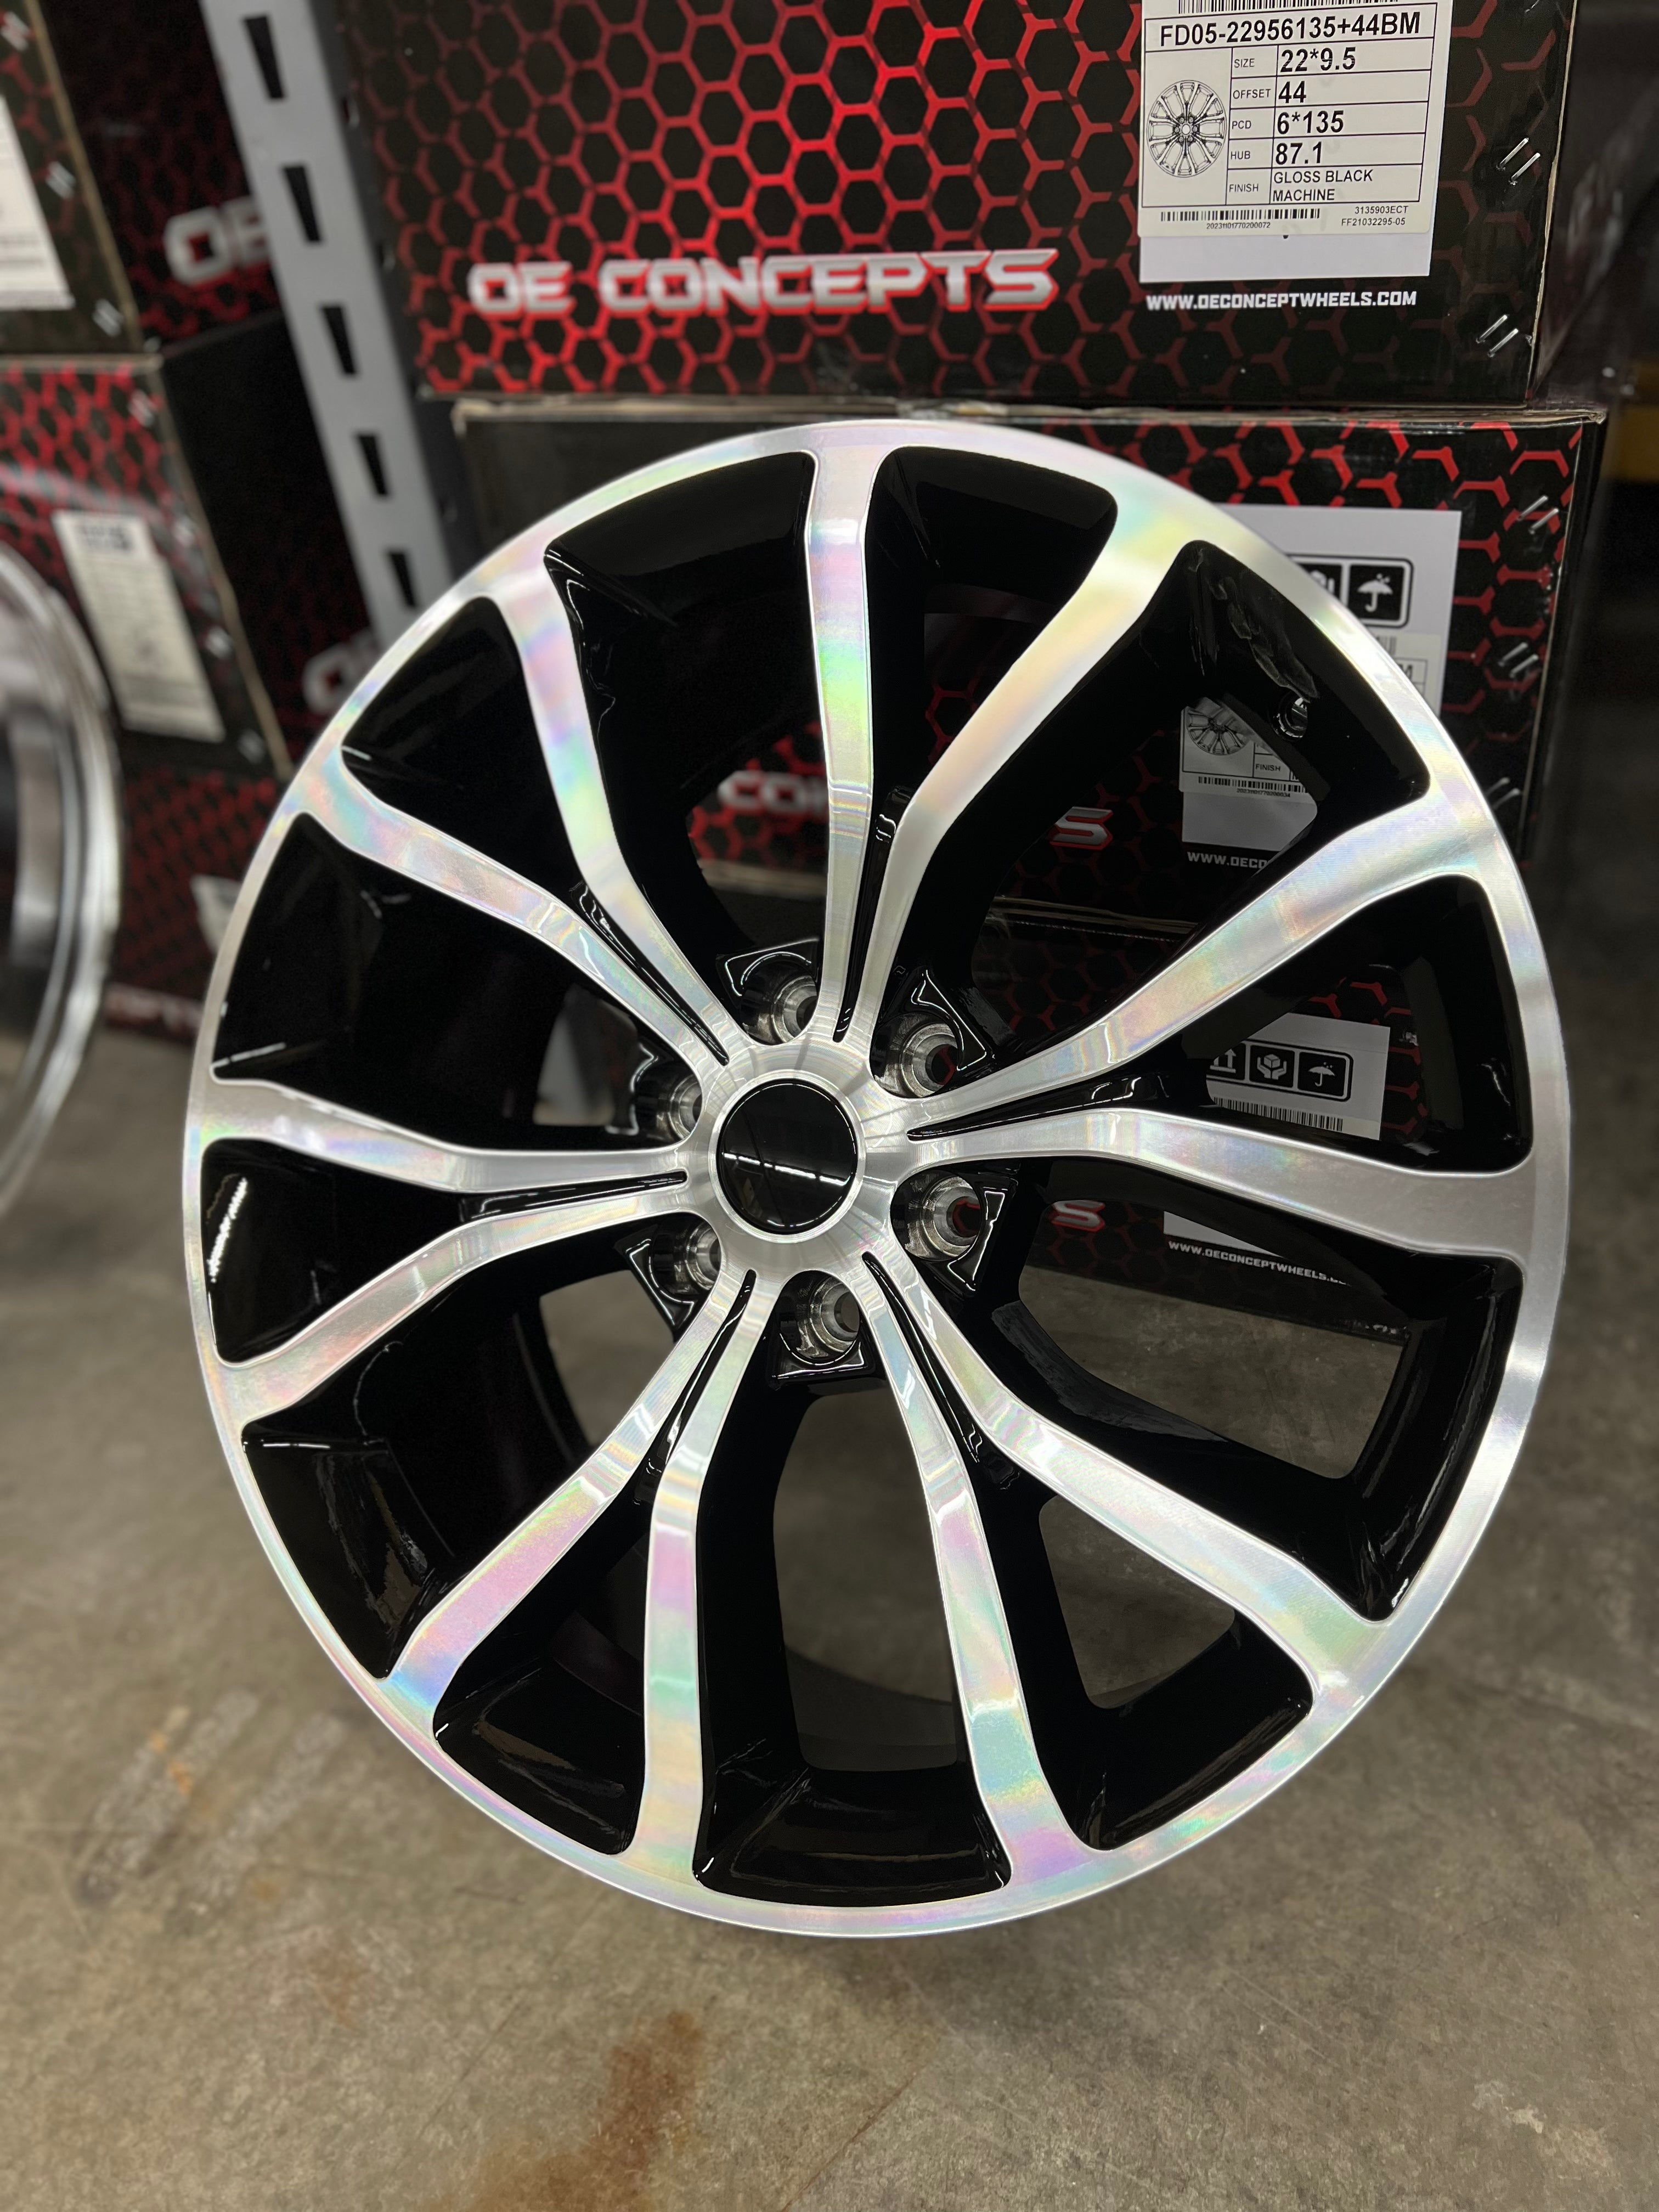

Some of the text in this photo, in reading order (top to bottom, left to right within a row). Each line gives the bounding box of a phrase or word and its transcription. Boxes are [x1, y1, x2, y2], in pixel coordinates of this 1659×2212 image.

[1160, 11, 1421, 47] FD05-22956135+44BM
[1233, 57, 1255, 69] SIZE
[1232, 81, 1307, 103] OFFSET 44
[1232, 120, 1252, 130] PCD
[1230, 142, 1323, 165] HUB 87.1
[1273, 169, 1374, 184] GLOSS BLACK
[1228, 184, 1335, 202] FINISH MACHINE
[1355, 205, 1409, 215] 3135903ECT
[1341, 217, 1406, 227] FF21032295-05
[467, 249, 1059, 316] OE CONCEPTS
[1146, 291, 1417, 311] WWW.OECONCEPTWHEELS.COM
[1255, 764, 1282, 772] FINISH
